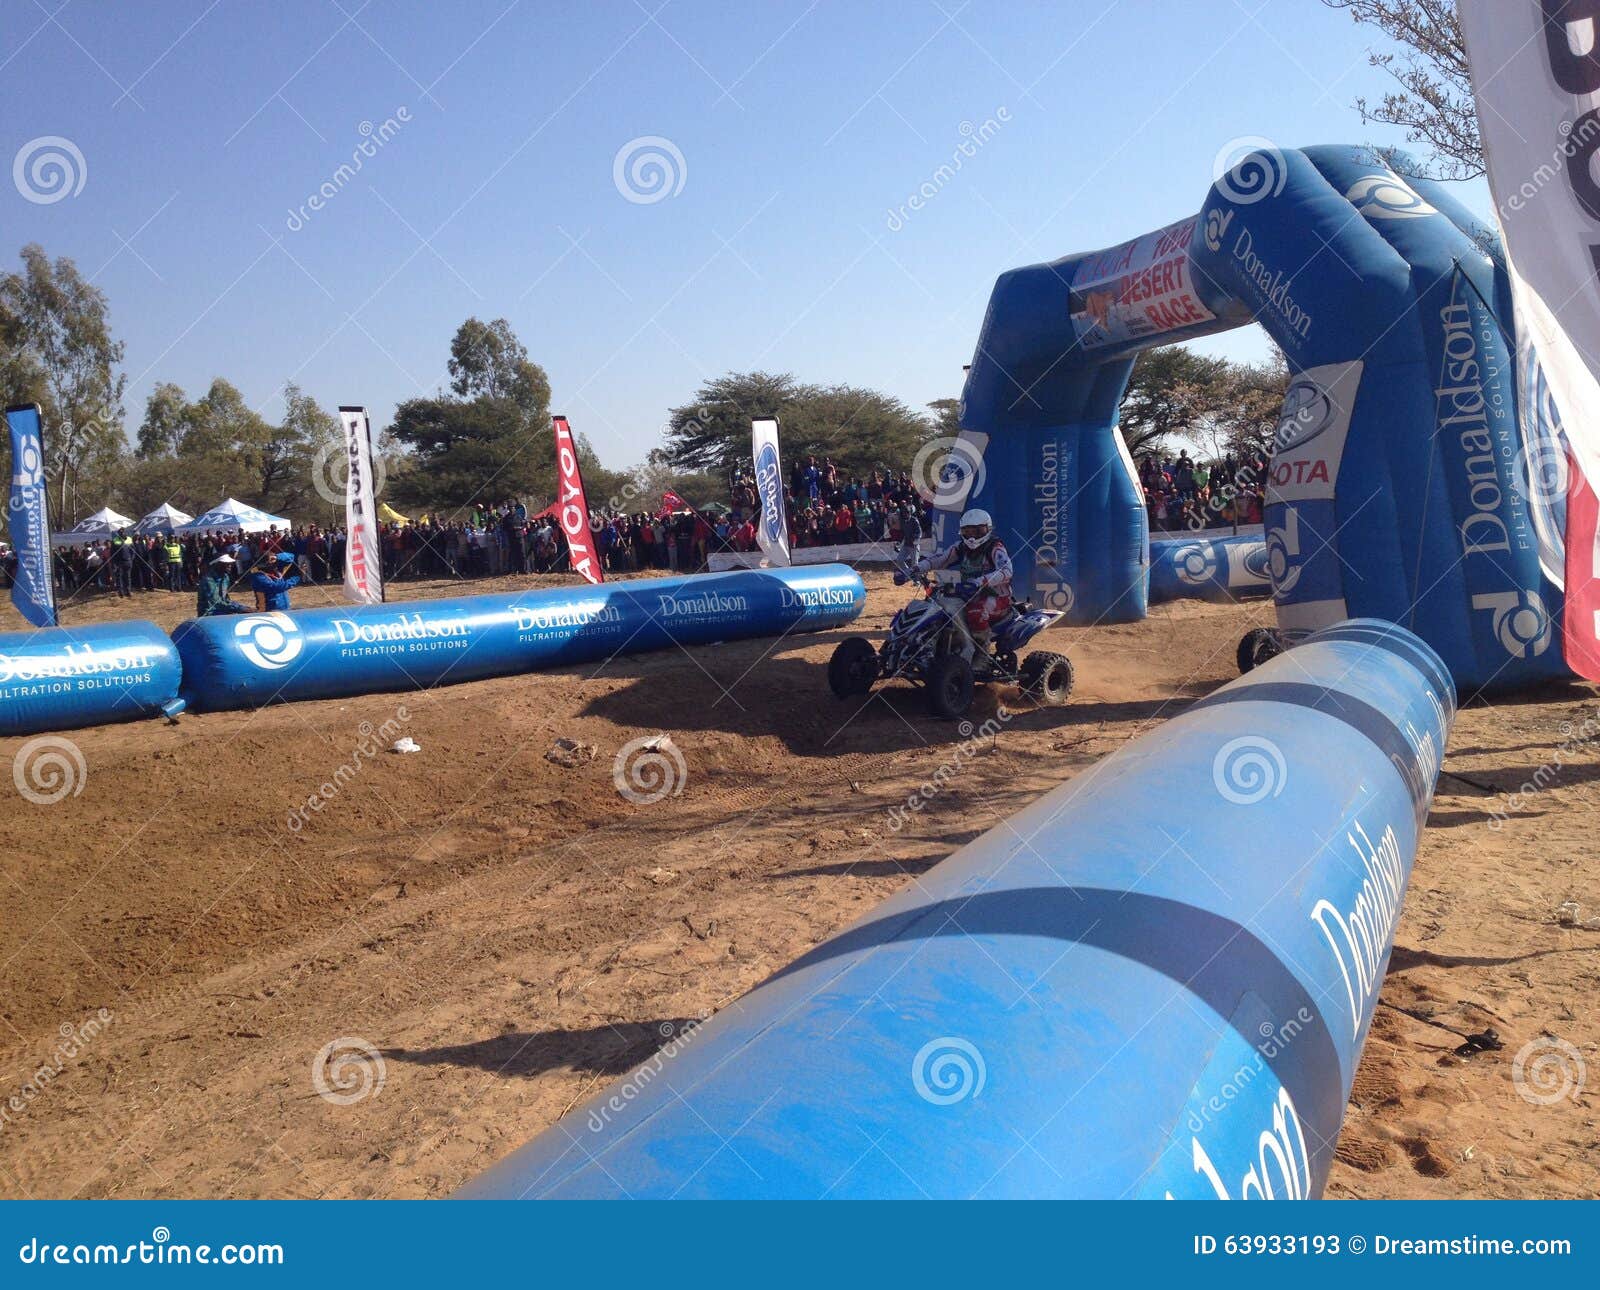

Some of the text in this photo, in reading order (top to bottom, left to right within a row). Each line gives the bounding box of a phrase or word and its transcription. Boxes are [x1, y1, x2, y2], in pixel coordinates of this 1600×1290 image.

[1120, 255, 1186, 305] DESERT
[1233, 227, 1311, 338] Donaldson
[1145, 295, 1204, 329] RACE
[1435, 303, 1511, 558] Donaldson
[1477, 302, 1529, 550] FILTRATION SOLUTIONS
[1035, 442, 1057, 567] Donaldson
[657, 591, 748, 616] Donaldson
[780, 586, 854, 607] Donaldson
[331, 613, 467, 645] Donaldson
[519, 631, 570, 643] FILTRATION
[341, 639, 468, 657] FILTRATION SOLUTIONS
[78, 673, 151, 690] SOLUTIONS
[1311, 819, 1403, 1043] Donaldson
